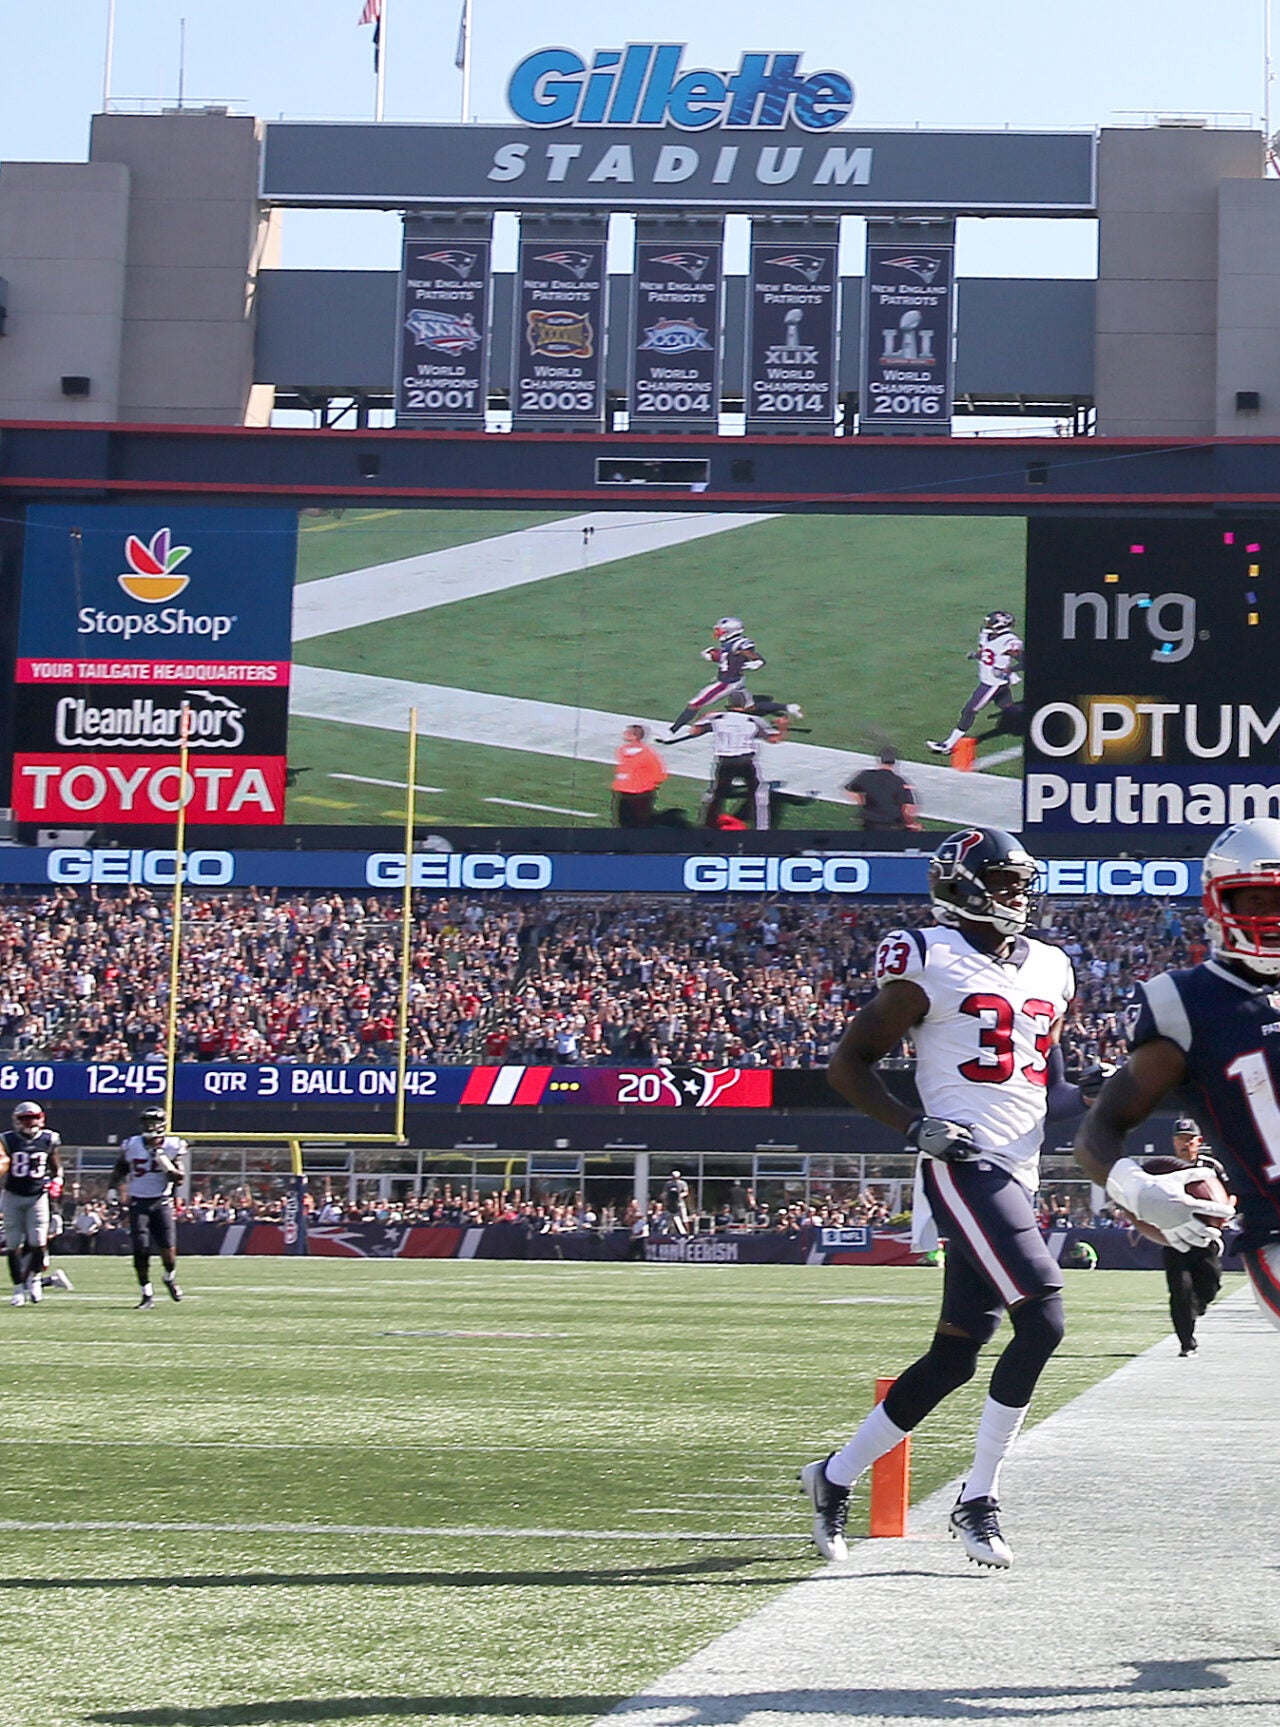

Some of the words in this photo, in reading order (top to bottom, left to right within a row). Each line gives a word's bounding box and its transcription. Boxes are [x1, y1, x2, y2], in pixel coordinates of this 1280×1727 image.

[506, 42, 855, 133] Gillette
[487, 143, 874, 186] STADIUM
[407, 279, 432, 289] NEW
[435, 280, 484, 289] ENGLAND
[524, 280, 549, 289] NEW
[551, 280, 600, 290] ENGLAND
[640, 281, 664, 291] NEW
[667, 282, 715, 292] ENGLAND
[755, 283, 781, 292] NEW
[782, 284, 832, 294] ENGLAND
[870, 284, 896, 294] NEW
[898, 284, 948, 295] ENGLAND
[415, 289, 475, 301] PATRIOTS
[532, 290, 591, 302] PATRIOTS
[648, 291, 707, 304] PATRIOTS
[763, 293, 823, 305] PATRIOTS
[879, 294, 939, 306] PATRIOTS
[764, 350, 820, 365] XLIX
[417, 364, 467, 376] WORLD
[534, 365, 583, 378] WORLD
[650, 367, 699, 379] WORLD
[767, 368, 816, 381] WORLD
[882, 369, 932, 382] WORLD
[403, 376, 480, 389] CHAMPIONS
[520, 377, 597, 391] CHAMPIONS
[636, 379, 713, 393] CHAMPIONS
[752, 380, 829, 393] CHAMPIONS
[868, 382, 946, 396] CHAMPIONS
[406, 390, 474, 409] 2001
[520, 392, 594, 411] 2003
[636, 393, 712, 412] 2004
[757, 394, 824, 412] 2014
[872, 396, 940, 415] 2016
[76, 607, 233, 641] Stop&Shop
[1061, 590, 1198, 664] nrg
[30, 662, 74, 678] YOUR
[78, 662, 150, 680] TAILGATE
[153, 664, 278, 682] HEADQUARTERS
[56, 696, 245, 748] CleanHarbors
[21, 764, 277, 813] TOYOTA
[46, 848, 236, 885] GEICO
[365, 852, 554, 891] GEICO
[682, 855, 871, 893] GEICO
[876, 942, 911, 978] 33
[957, 992, 1056, 1087] 33
[0, 1066, 20, 1091] &
[25, 1065, 55, 1092] 10
[86, 1064, 168, 1095] 12:45
[204, 1070, 248, 1093] QTR
[257, 1065, 280, 1096] 3
[290, 1068, 351, 1095] BALL
[359, 1069, 397, 1096] ON
[404, 1070, 438, 1096] 42
[616, 1073, 662, 1103] 20
[11, 1151, 49, 1178] 83
